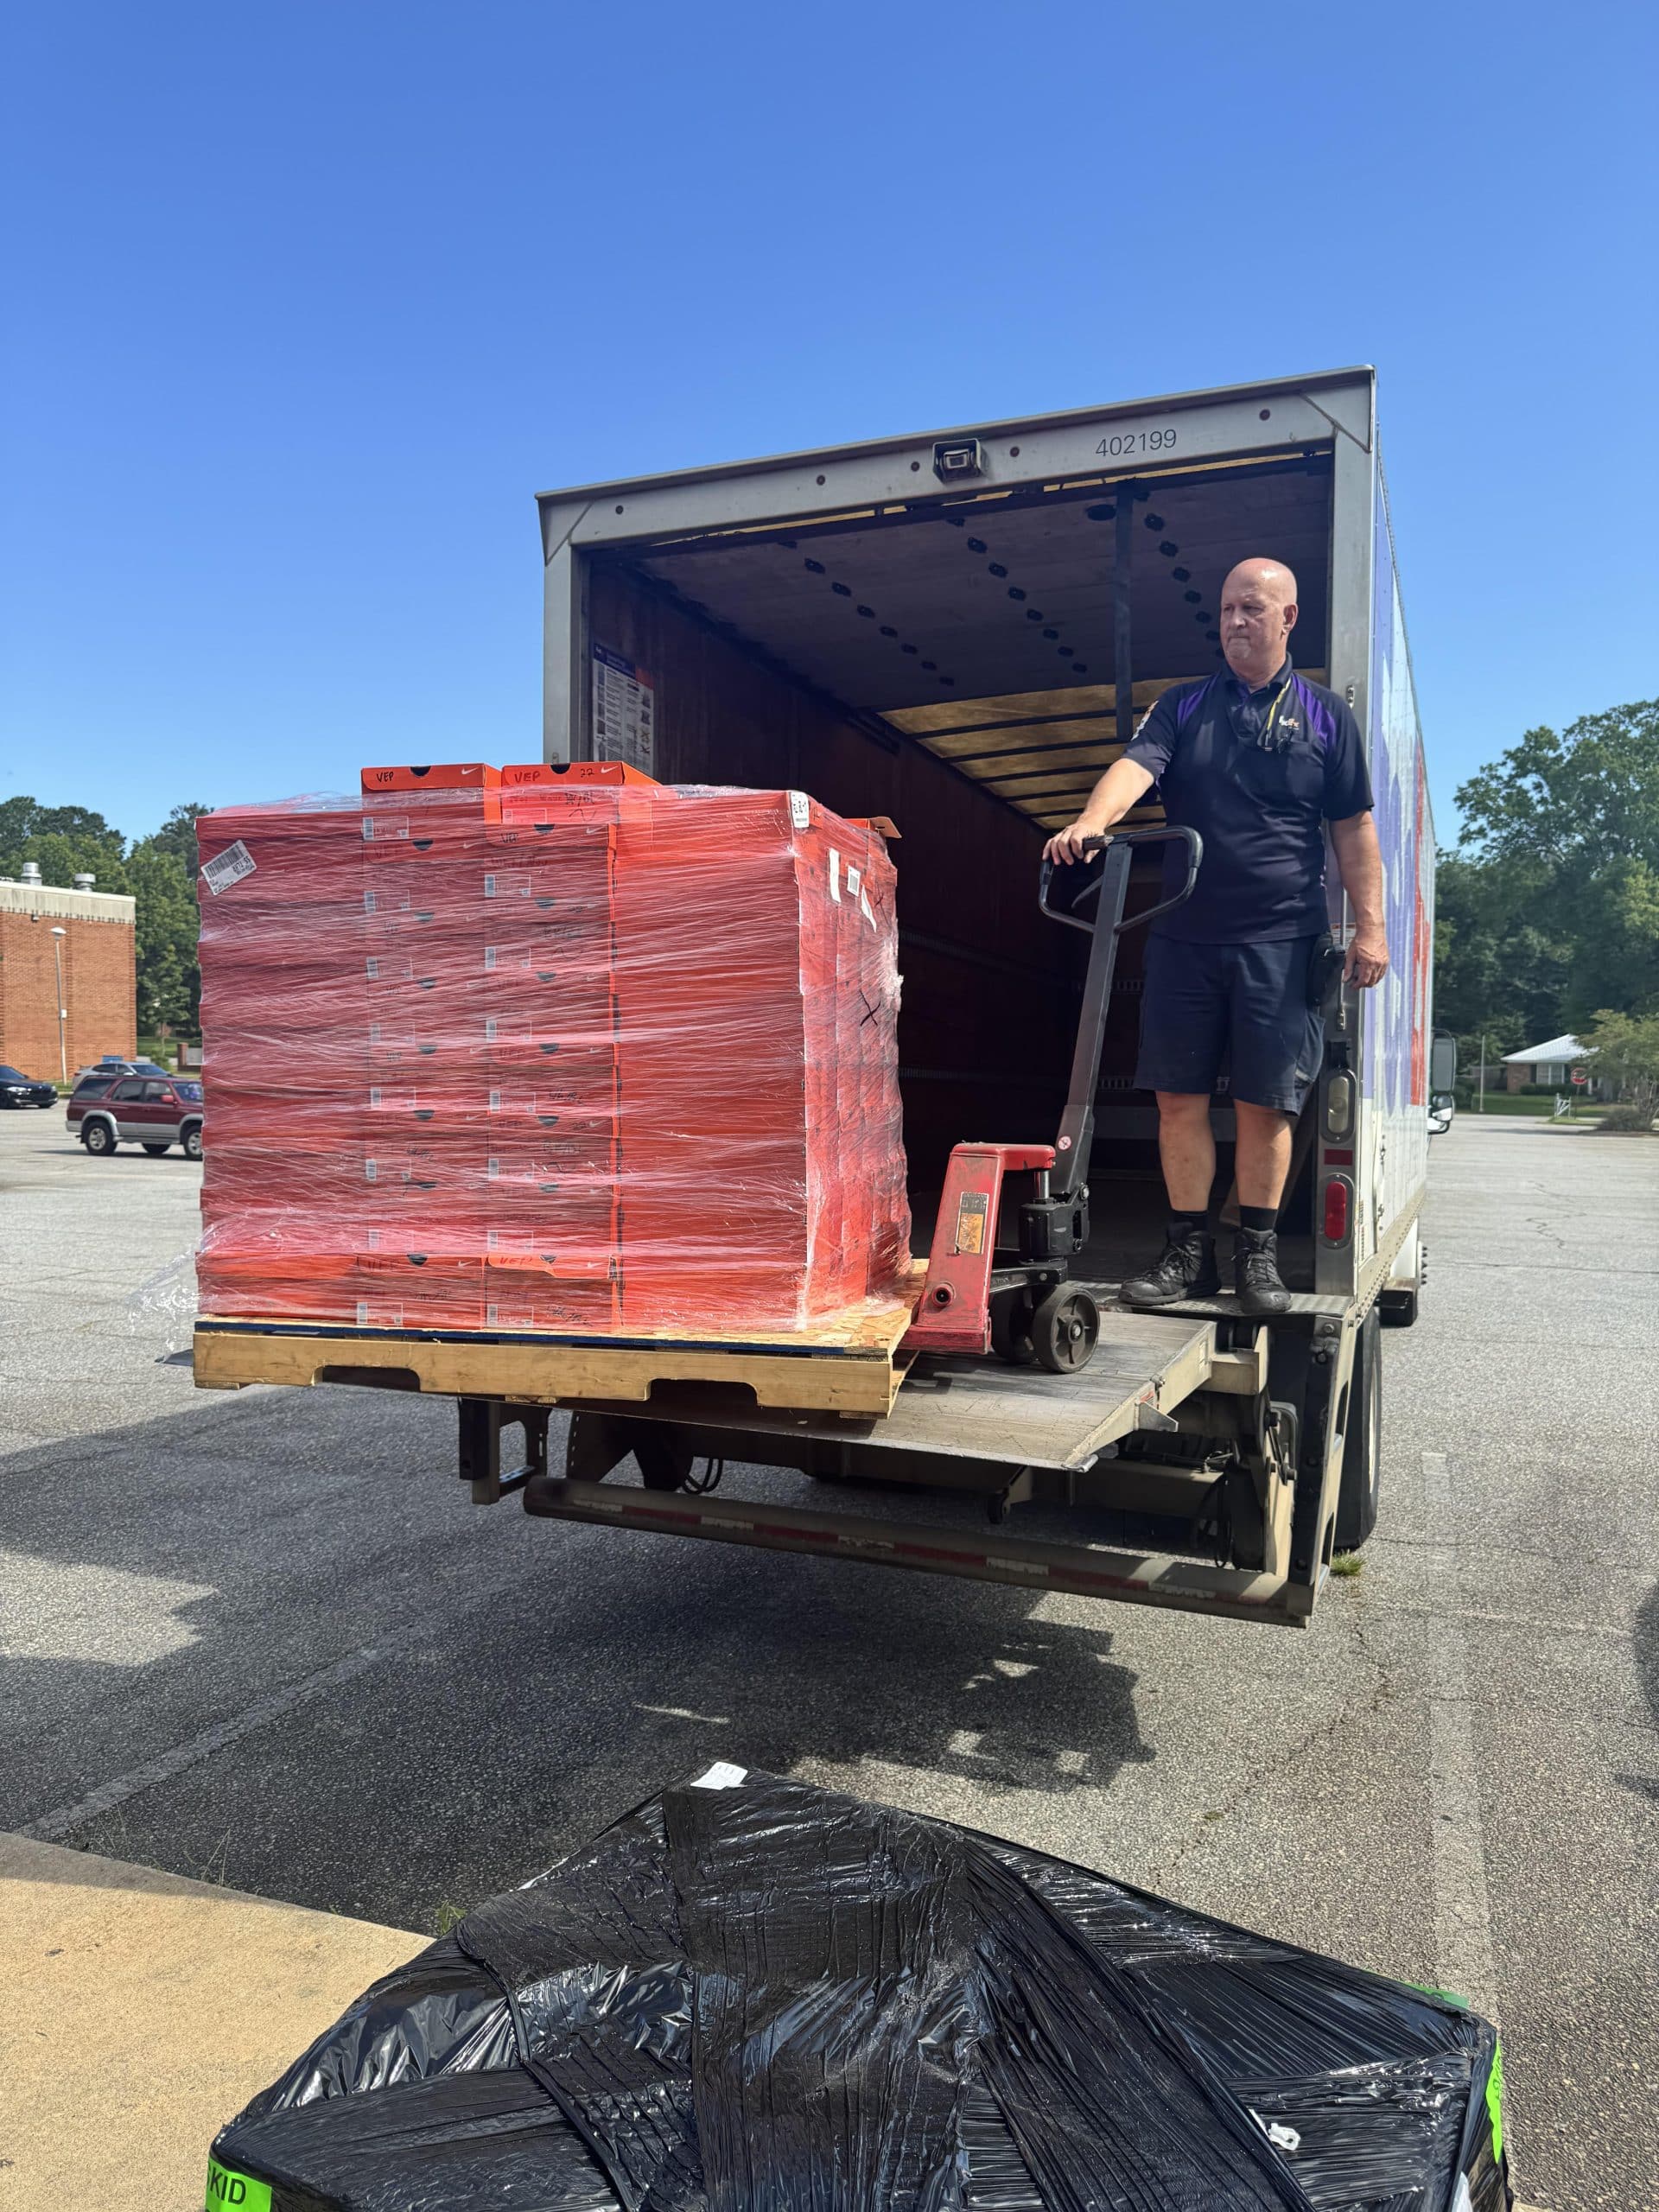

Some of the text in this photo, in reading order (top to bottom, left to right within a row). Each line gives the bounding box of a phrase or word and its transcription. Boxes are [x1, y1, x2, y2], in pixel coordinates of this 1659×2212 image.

[1095, 429, 1177, 457] 402199
[376, 771, 394, 783] VEP
[514, 767, 594, 784] VEP 22
[207, 2160, 246, 2205] KID
